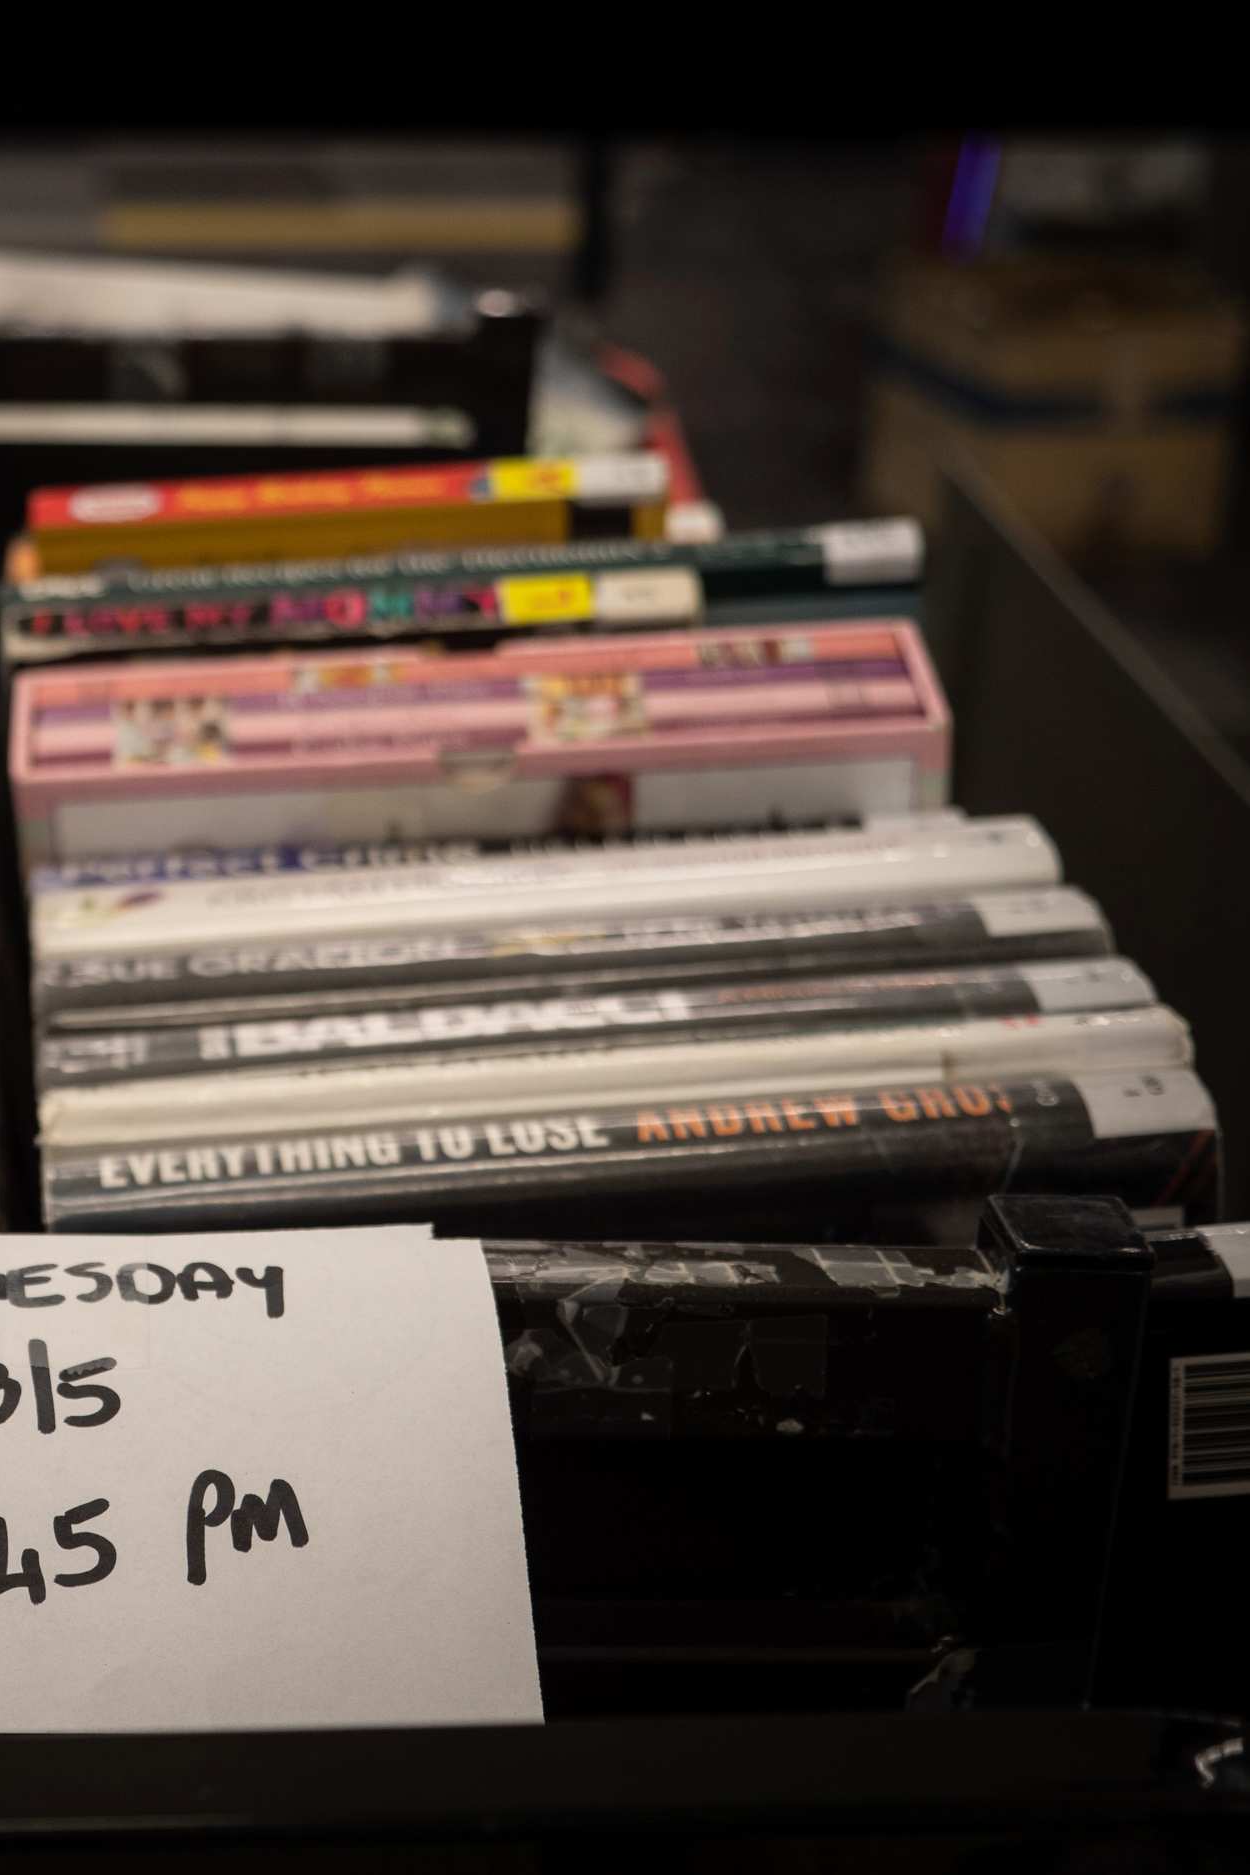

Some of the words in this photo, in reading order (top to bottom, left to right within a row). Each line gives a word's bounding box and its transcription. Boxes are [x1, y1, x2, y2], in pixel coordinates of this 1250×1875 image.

[99, 1130, 401, 1189] EVERYTHING
[414, 1122, 473, 1162] TO
[482, 1115, 610, 1157] LOSE
[636, 1092, 861, 1143] ANDREW
[185, 1467, 310, 1586] PM
